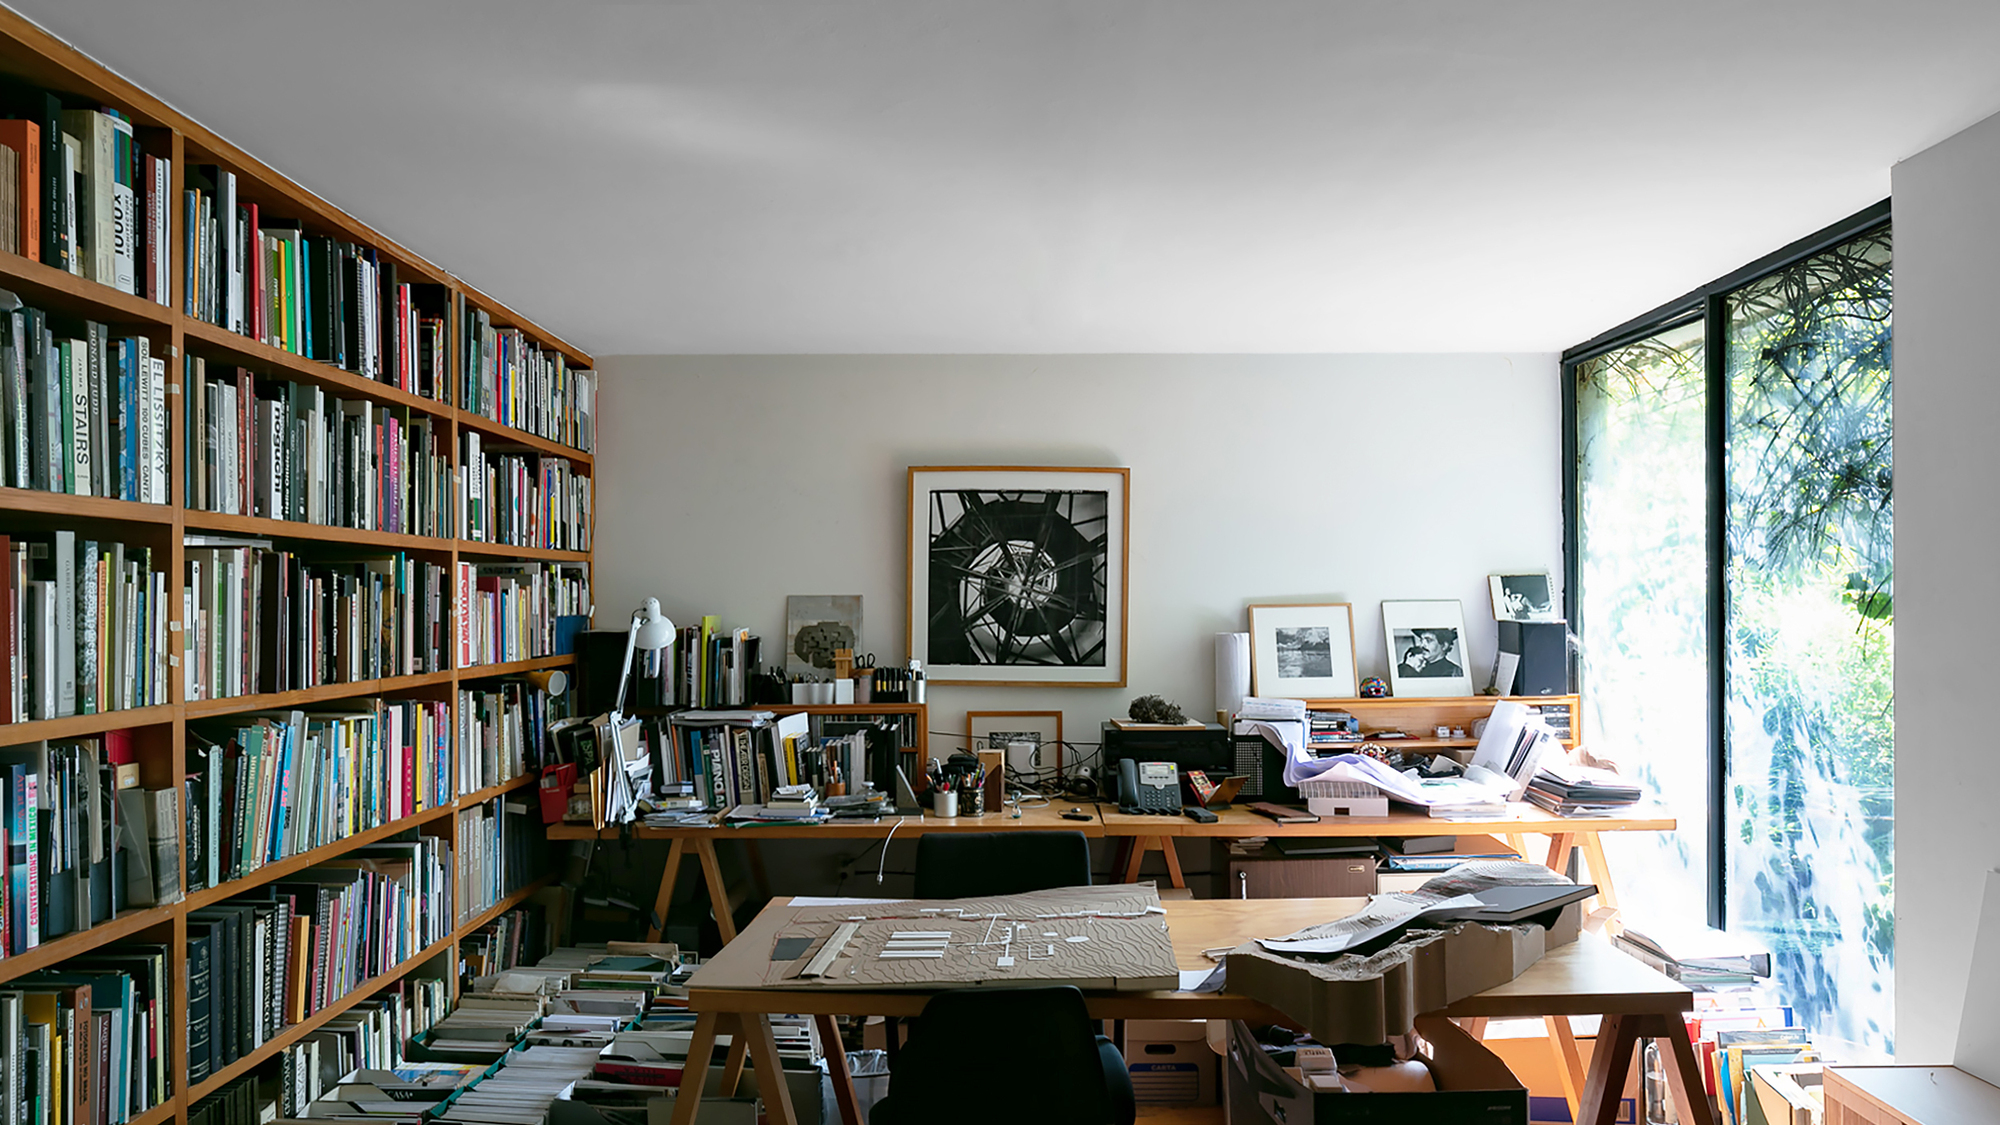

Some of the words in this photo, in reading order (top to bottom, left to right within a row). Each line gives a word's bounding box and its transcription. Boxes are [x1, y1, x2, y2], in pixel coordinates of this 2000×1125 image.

[90, 328, 98, 379] DONALD
[153, 361, 163, 381] EL
[91, 381, 99, 414] JUDD
[141, 364, 149, 402] LEWITT
[75, 394, 90, 465] STAIRS
[153, 387, 165, 474] LISSITZKY
[272, 406, 282, 493] noguchi
[17, 774, 25, 792] Art
[248, 754, 258, 795] MODERN
[710, 749, 724, 790] PIANO
[246, 795, 255, 817] ART
[281, 789, 289, 808] ART
[17, 808, 26, 839] Work
[29, 806, 37, 841] MEXICO
[29, 853, 38, 926] CONVERSATIONS
[265, 958, 271, 975] OF
[101, 1019, 109, 1063] VAQUERO
